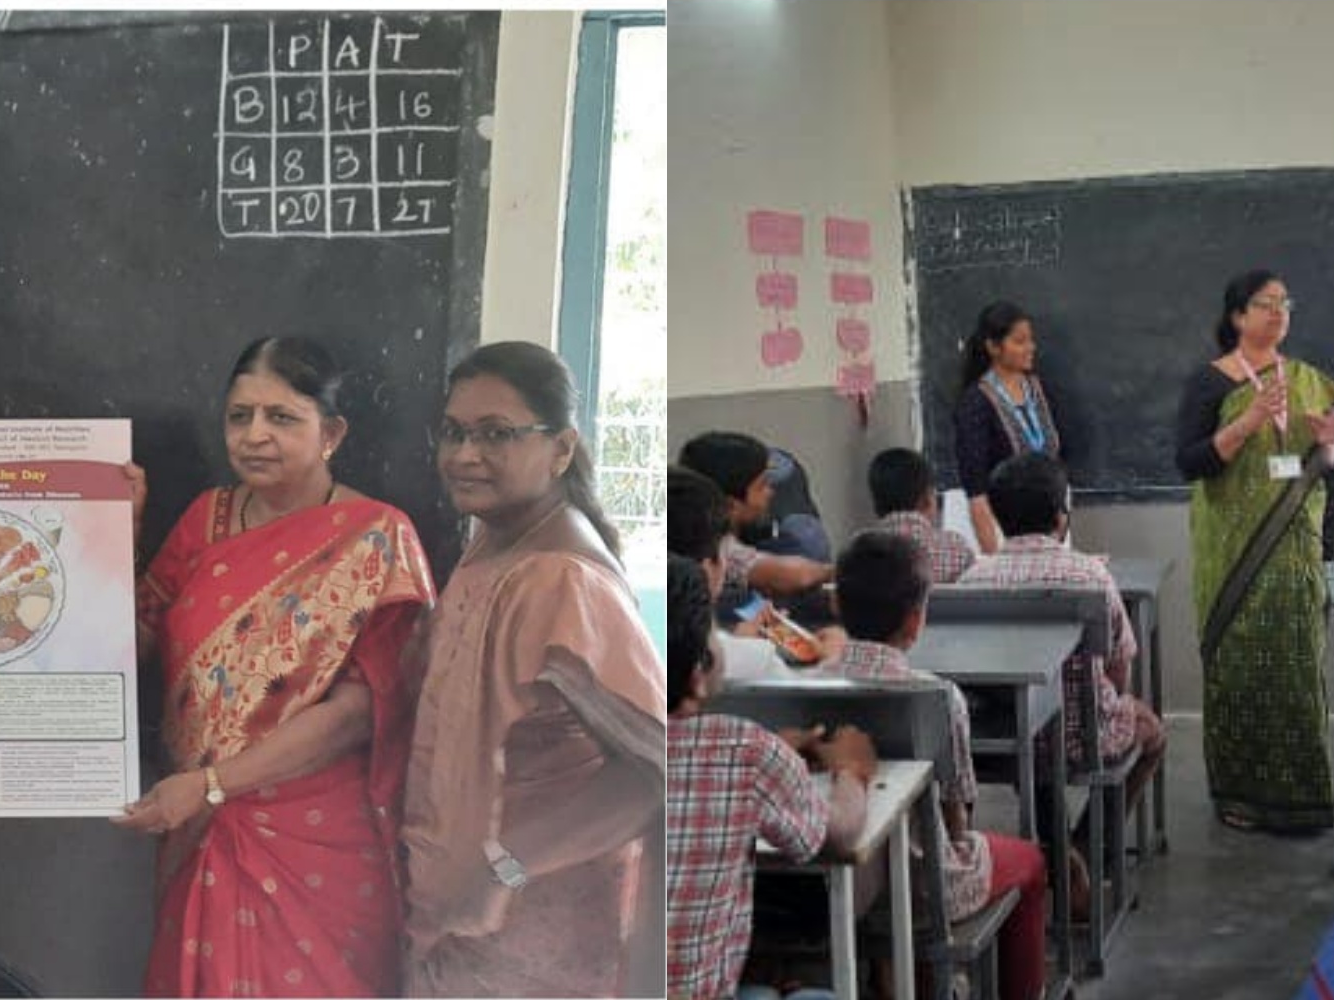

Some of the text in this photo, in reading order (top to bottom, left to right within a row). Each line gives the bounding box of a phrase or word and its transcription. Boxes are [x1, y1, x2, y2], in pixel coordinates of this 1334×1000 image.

[288, 31, 420, 68] P A T
[233, 86, 432, 124] B 12 4 16
[283, 148, 305, 182] 8
[334, 145, 360, 179] 3
[398, 142, 425, 176] 11
[232, 192, 432, 226] T 20 7 27
[22, 468, 47, 483] Day
